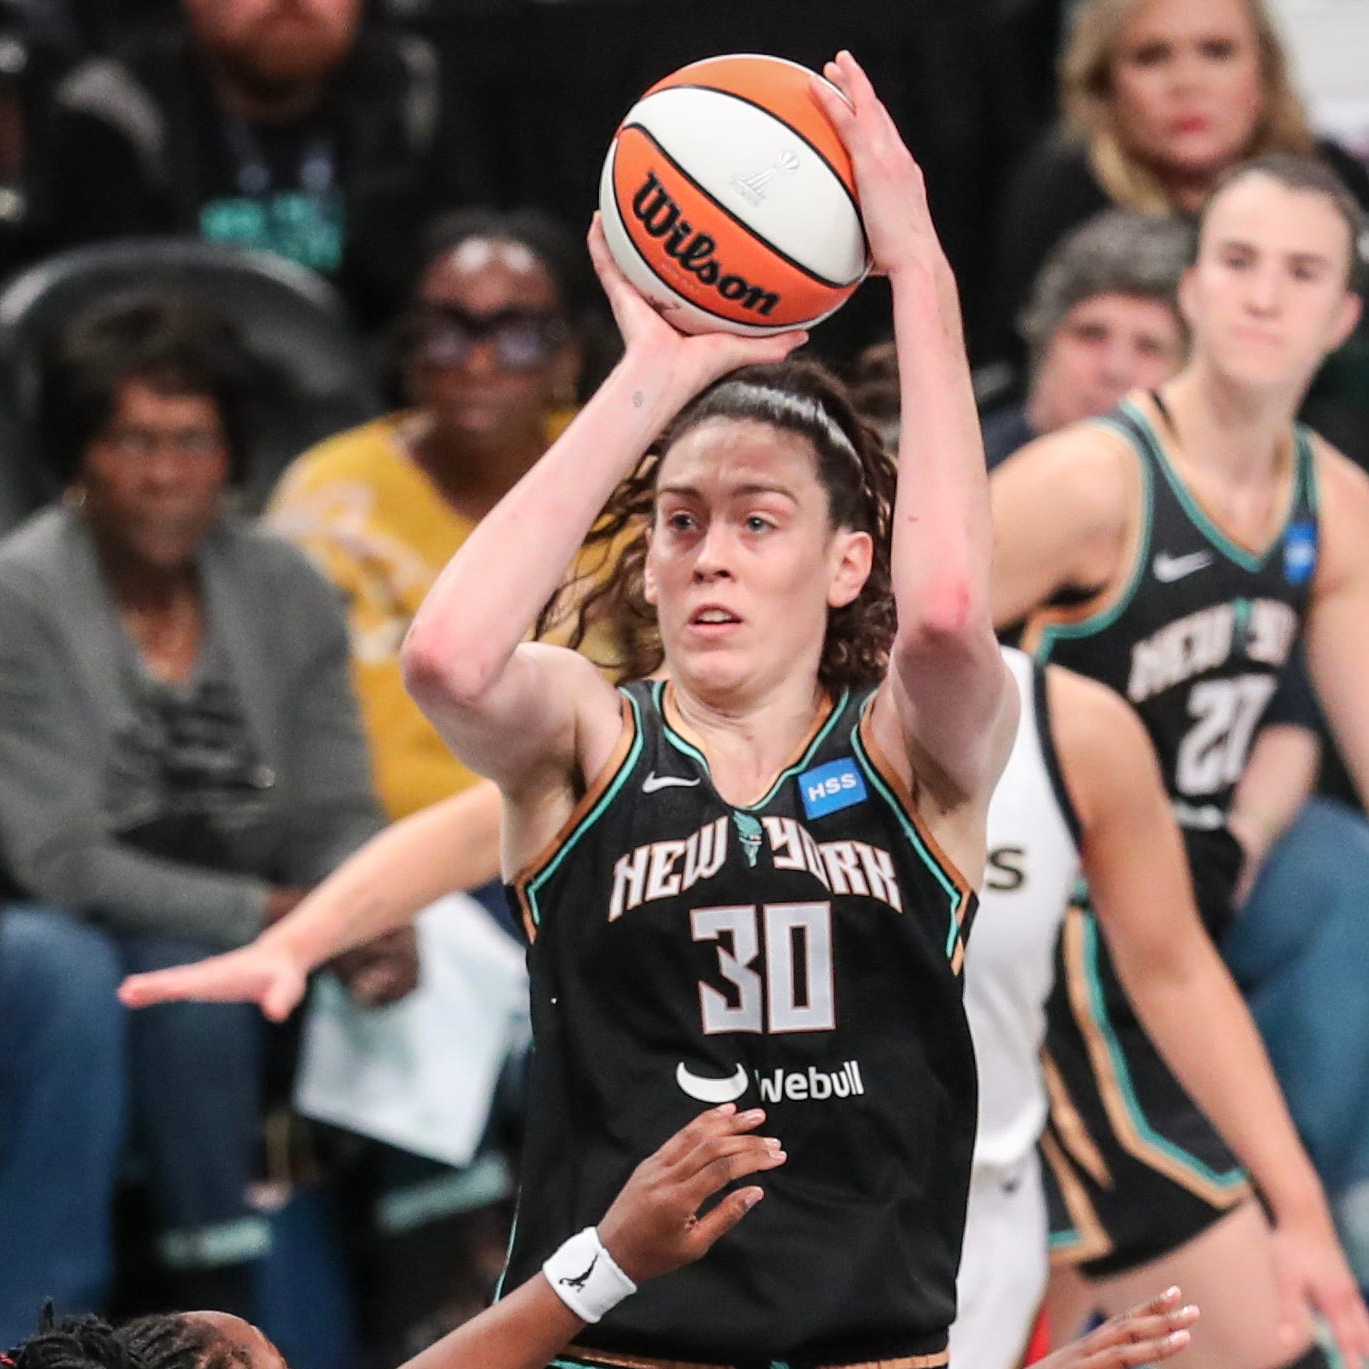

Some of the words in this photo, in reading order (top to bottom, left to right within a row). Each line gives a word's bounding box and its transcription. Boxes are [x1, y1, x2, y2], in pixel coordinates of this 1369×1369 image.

[632, 170, 781, 316] Wilson
[808, 773, 857, 802] HSS
[608, 815, 729, 923] NEW
[761, 815, 903, 915] YORK
[689, 900, 837, 1036] 30
[753, 1060, 865, 1103] Webull
